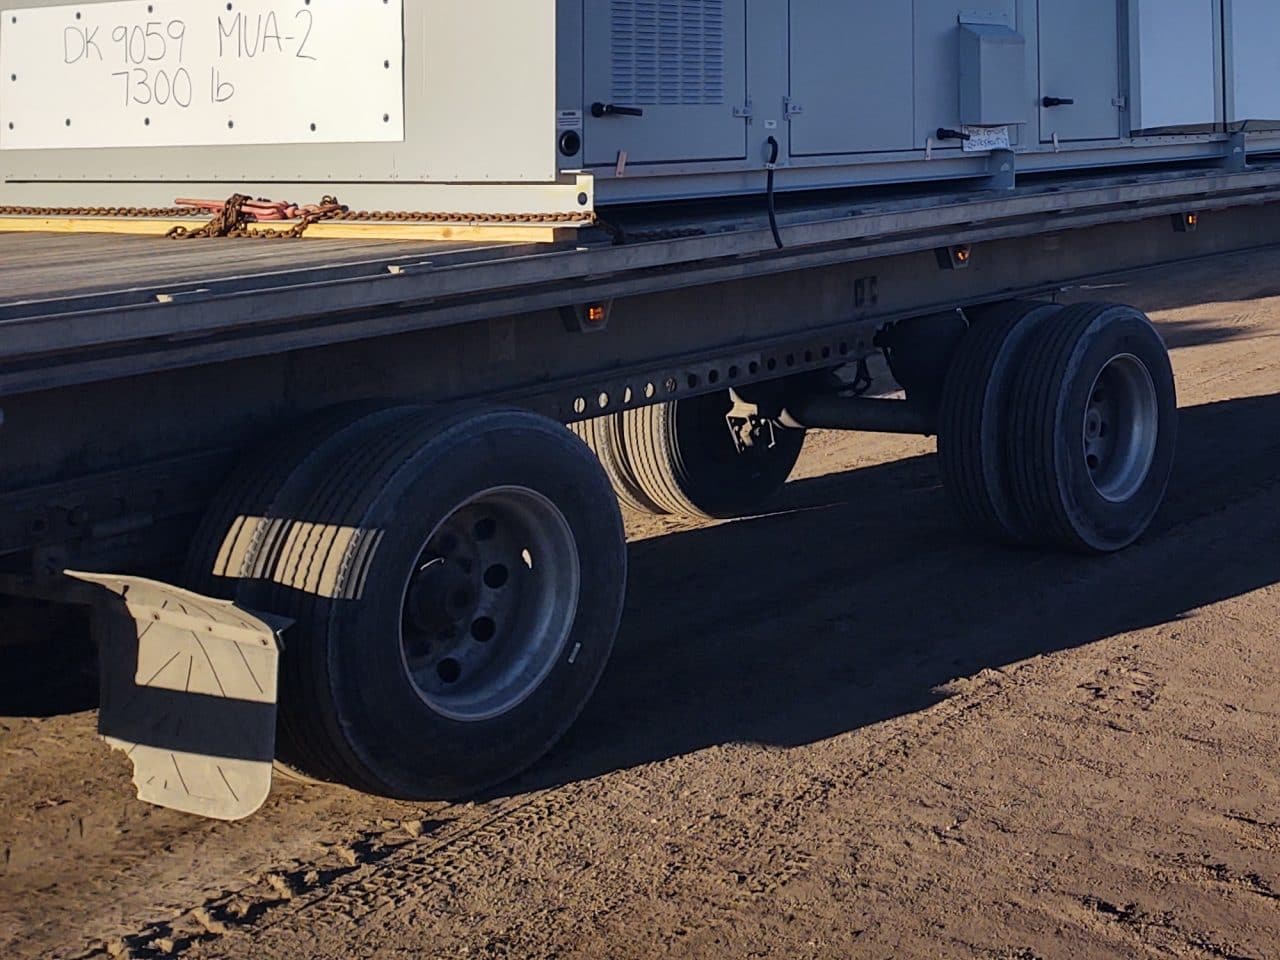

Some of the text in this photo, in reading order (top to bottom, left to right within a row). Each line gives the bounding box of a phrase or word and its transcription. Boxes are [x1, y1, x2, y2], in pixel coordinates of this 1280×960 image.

[63, 9, 317, 64] DK 9059 MUA-2
[112, 66, 235, 107] 7300 lb
